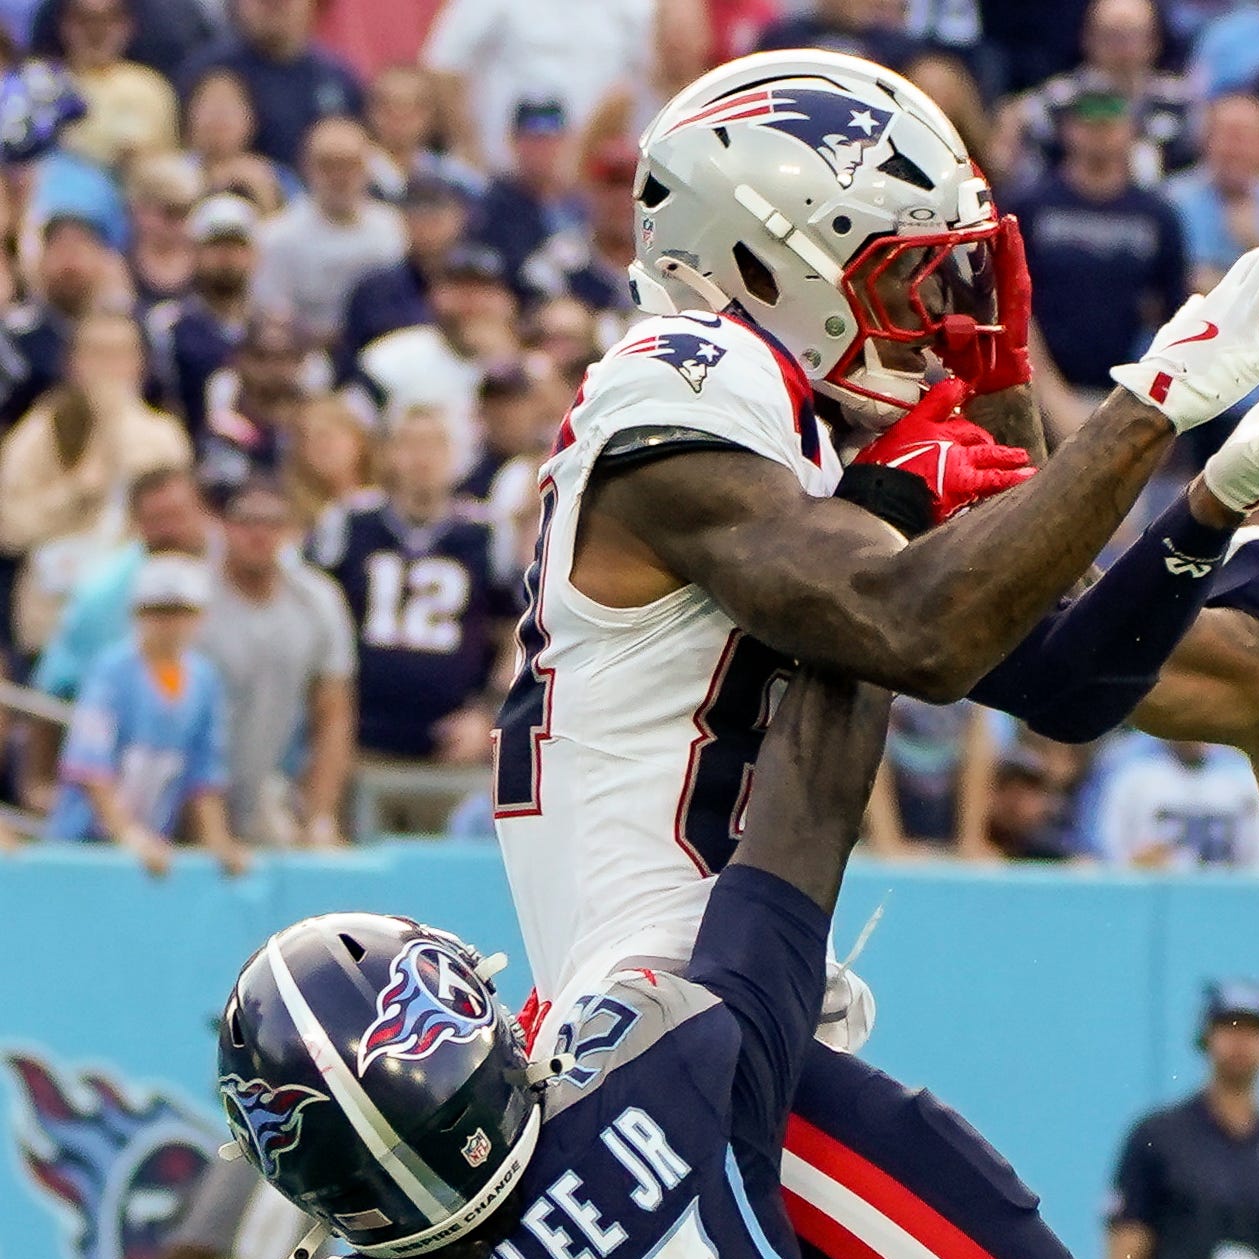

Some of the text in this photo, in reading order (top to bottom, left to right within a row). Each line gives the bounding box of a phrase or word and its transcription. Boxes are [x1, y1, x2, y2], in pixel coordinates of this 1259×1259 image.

[363, 550, 469, 653] 12
[463, 1159, 522, 1224] CHANGE
[599, 1106, 693, 1212] JR
